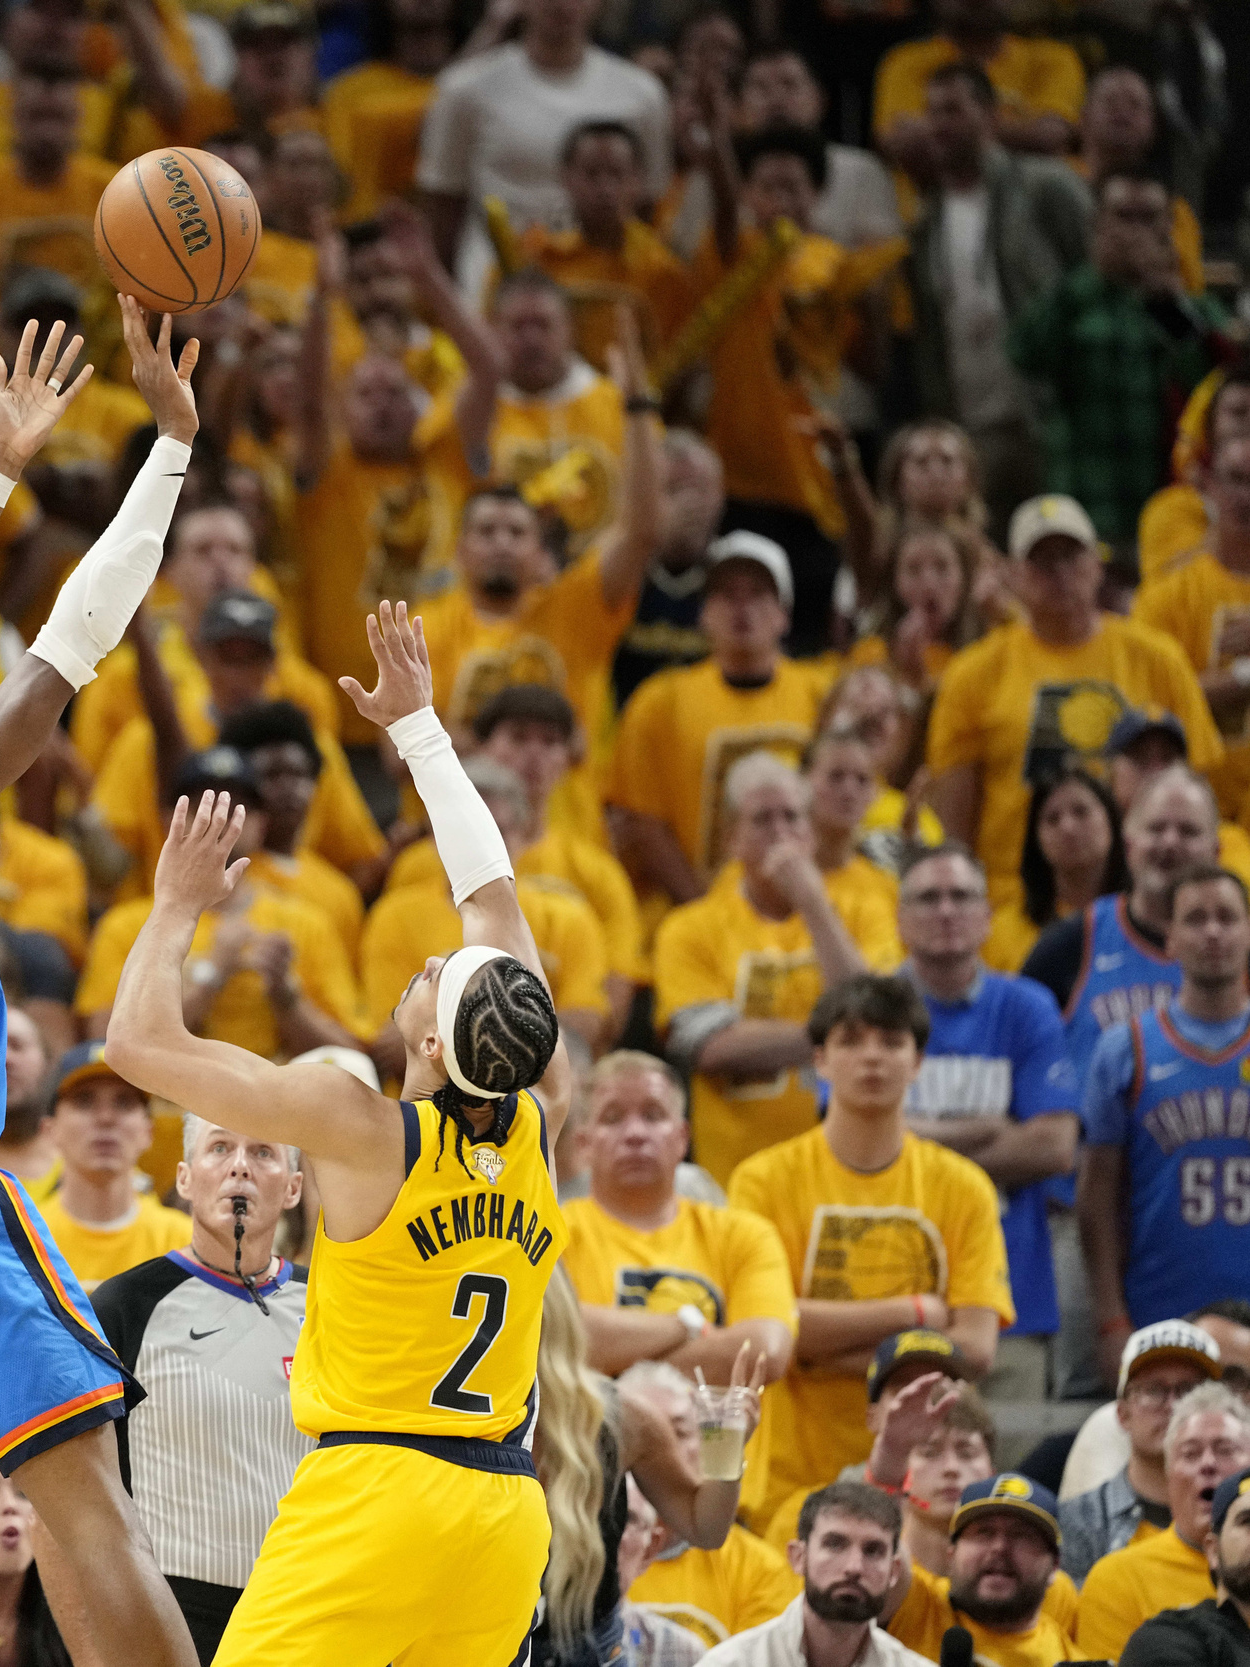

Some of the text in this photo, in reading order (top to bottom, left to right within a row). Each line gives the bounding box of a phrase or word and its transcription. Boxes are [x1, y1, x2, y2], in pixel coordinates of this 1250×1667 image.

[155, 154, 213, 258] Wilson
[1143, 1086, 1250, 1156] THUND
[1181, 1157, 1250, 1225] 55
[406, 1192, 553, 1267] NEMBHARD
[429, 1272, 510, 1415] 2
